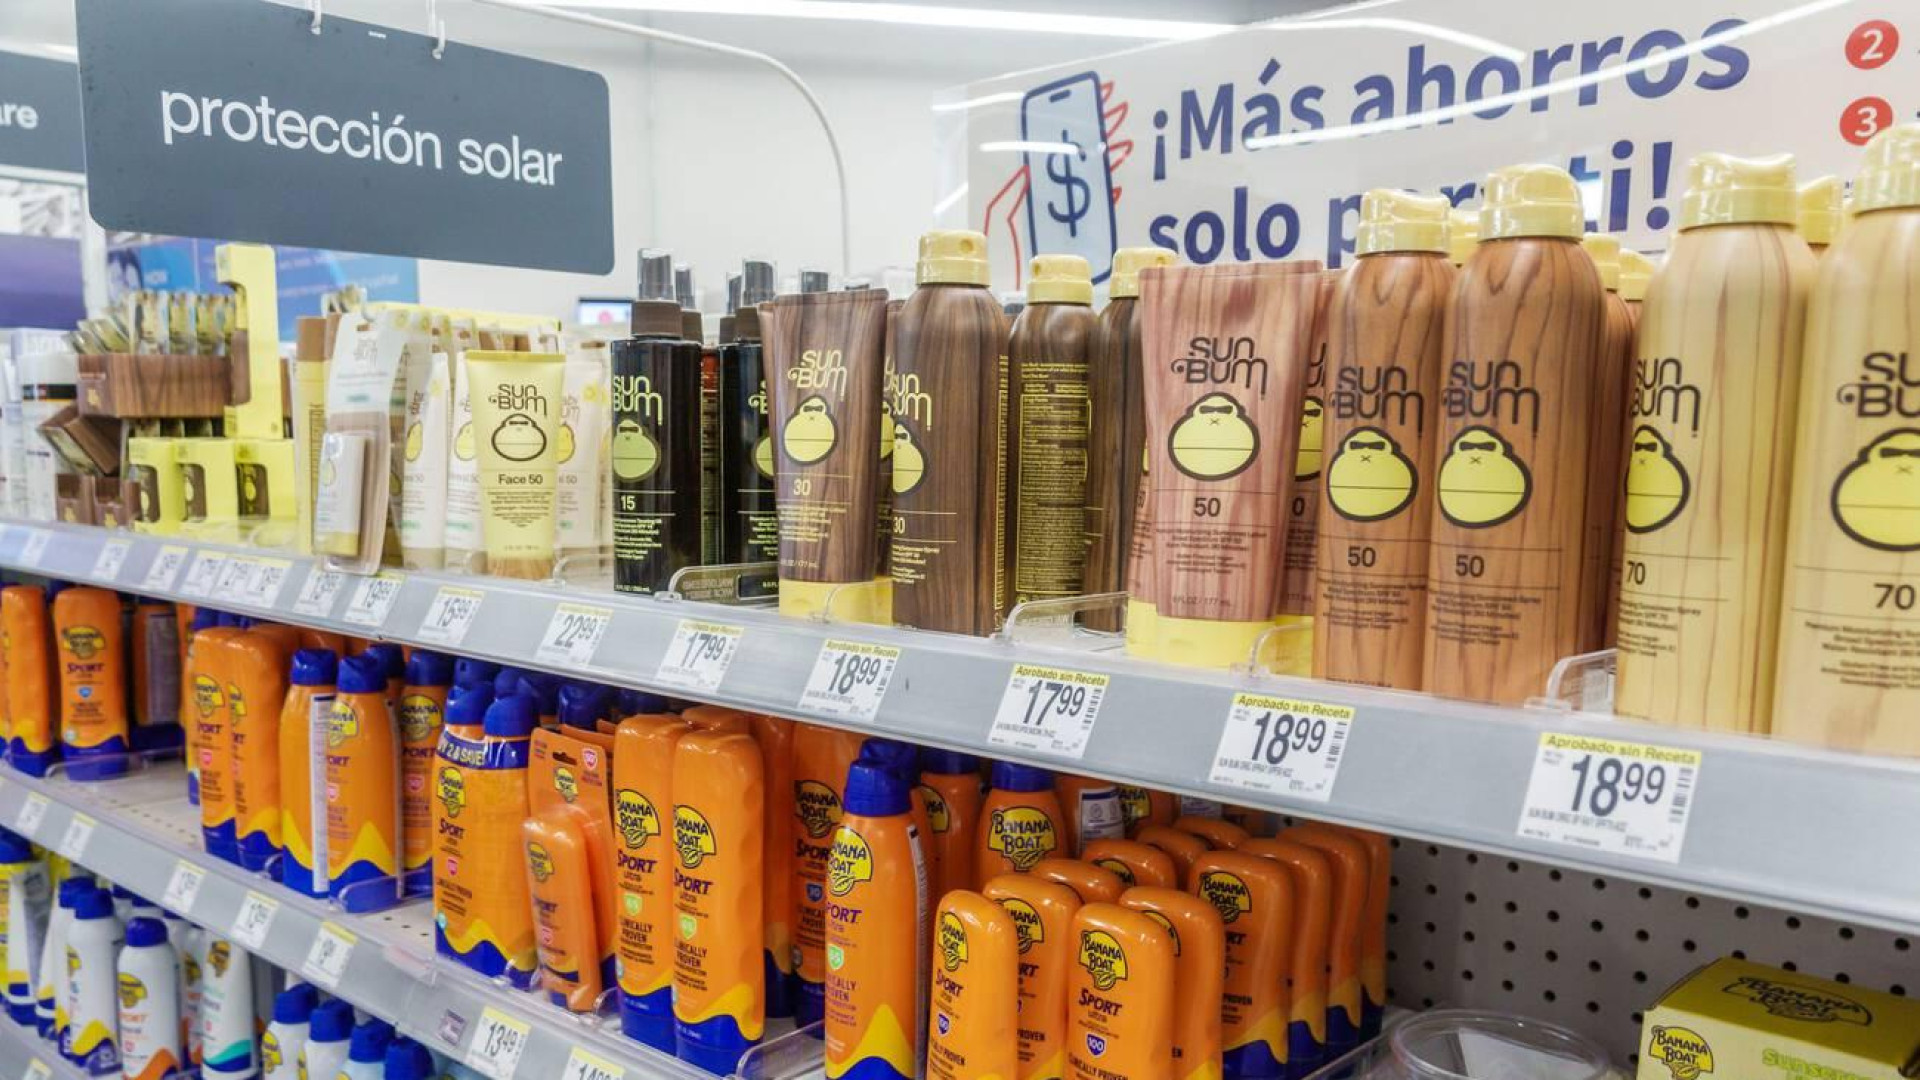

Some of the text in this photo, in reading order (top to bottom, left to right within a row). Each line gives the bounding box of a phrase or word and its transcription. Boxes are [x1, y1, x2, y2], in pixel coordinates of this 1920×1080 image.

[1860, 28, 1884, 61] 2
[1153, 15, 1751, 182] ¡Más ahorros
[0, 104, 39, 129] re
[1855, 106, 1879, 137] 3
[161, 89, 563, 187] protección solar
[1149, 186, 1301, 265] solo
[498, 474, 544, 485] Face 50
[793, 479, 812, 496] 30
[620, 495, 637, 511] 15
[1194, 497, 1221, 518] 50
[1347, 546, 1377, 568] 50
[1455, 555, 1485, 578] 50
[1626, 562, 1647, 585] 70
[1874, 584, 1916, 611] 70
[829, 653, 881, 695] 1899
[1016, 665, 1106, 685] Aprobado sin Receta
[1023, 679, 1085, 726] 1799
[1238, 695, 1351, 719] Aprobado sin Receta
[1251, 711, 1326, 765] 1899
[1547, 735, 1697, 765] Aprobado sin Receta
[1571, 754, 1666, 818] 1899
[993, 811, 1051, 835] BANANA
[1002, 834, 1042, 855] BOAT
[617, 848, 658, 873] SPORT
[673, 867, 715, 895] SPORT
[1083, 932, 1122, 961] BANANA
[1088, 952, 1115, 972] BOAT
[936, 969, 964, 998] SPORT
[1079, 987, 1122, 1017] SPORT
[1655, 1028, 1709, 1055] BANANA
[1662, 1045, 1699, 1066] BOAT
